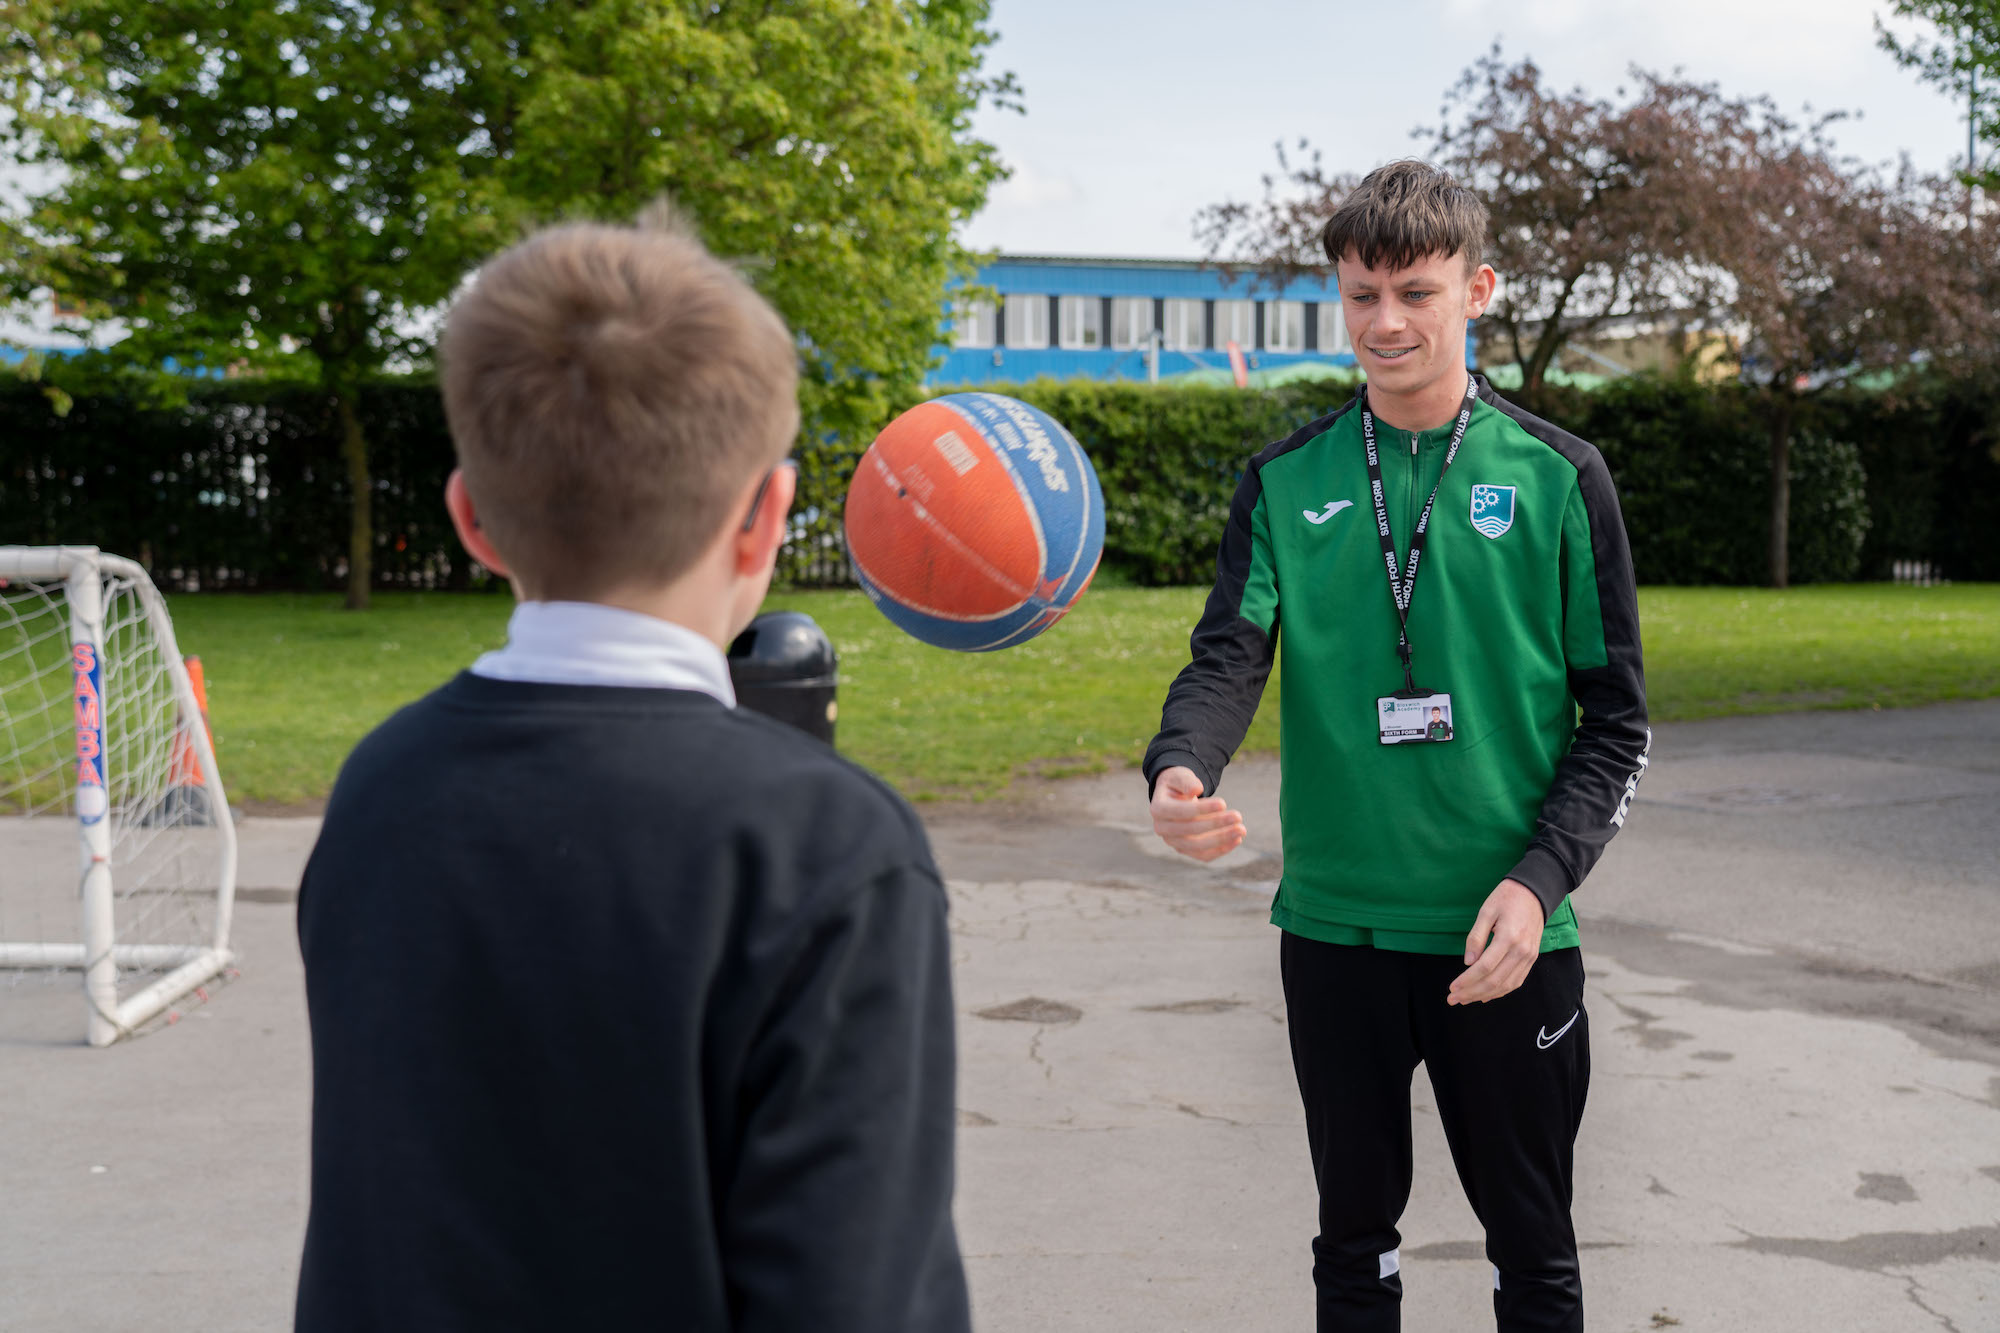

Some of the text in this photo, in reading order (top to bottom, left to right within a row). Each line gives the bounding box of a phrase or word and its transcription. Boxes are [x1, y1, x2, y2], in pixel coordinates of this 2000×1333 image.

[1363, 412, 1378, 466] SIXTH FORM
[1446, 409, 1470, 464] SIXTH FORM
[1372, 479, 1389, 536] SIXTH FORM
[1416, 505, 1431, 534] FORM
[1385, 551, 1404, 610] SIXTH FORM
[1405, 549, 1420, 578] SIXTH
[73, 643, 102, 785] SAMBA
